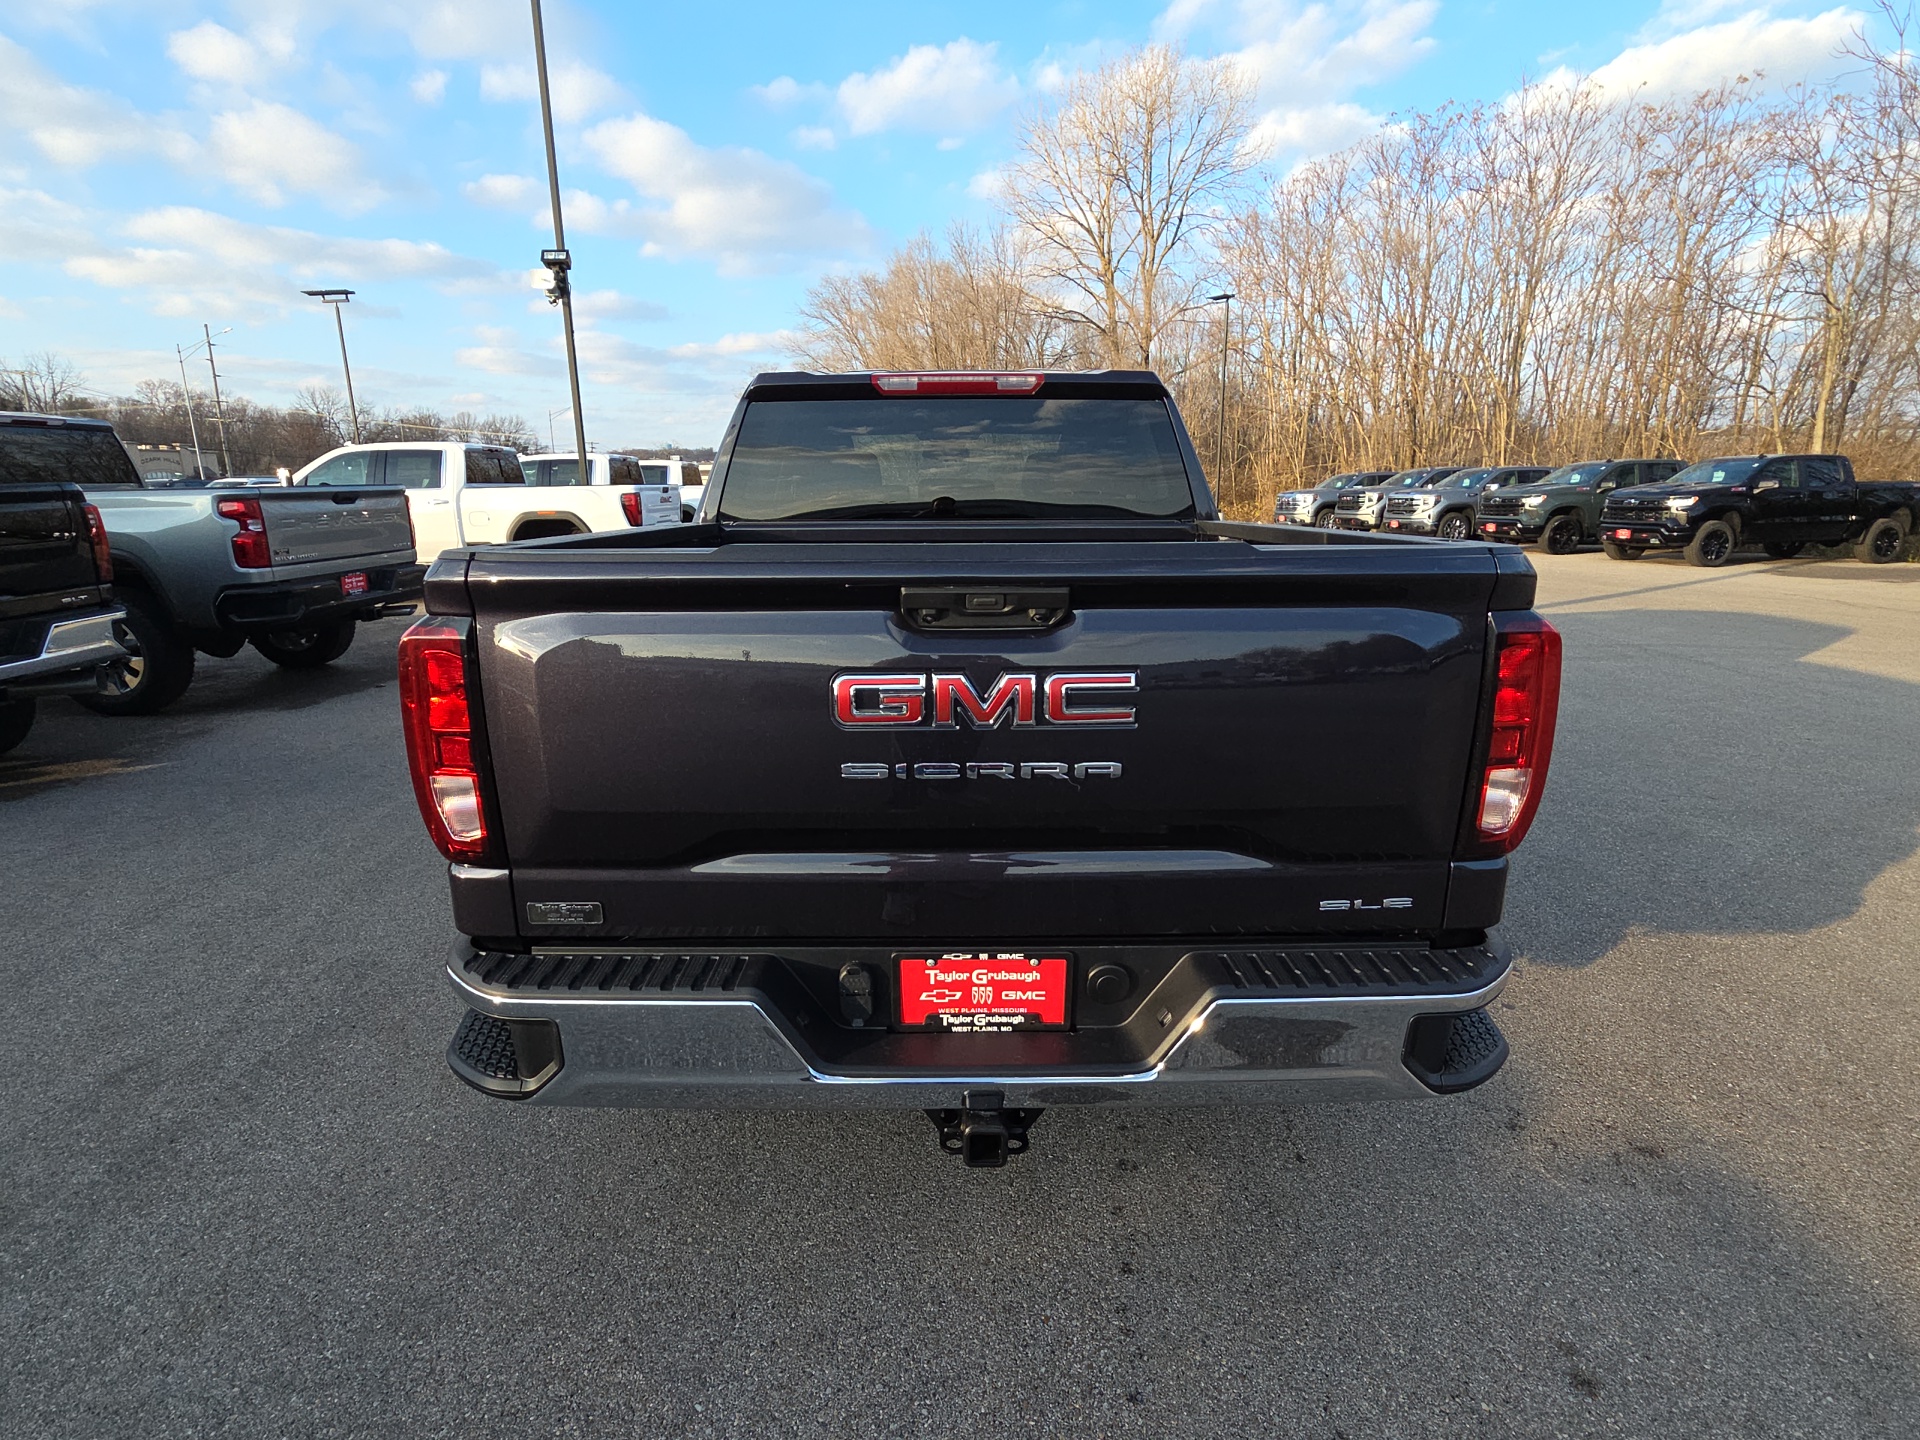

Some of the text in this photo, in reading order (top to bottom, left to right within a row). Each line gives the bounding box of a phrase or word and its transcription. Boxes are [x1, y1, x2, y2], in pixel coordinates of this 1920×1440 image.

[831, 670, 1140, 730] GMC
[841, 762, 1122, 779] SIERRA
[1319, 897, 1413, 911] SLE
[925, 969, 1040, 985] Taylor Grubaugh
[1001, 990, 1046, 1000] GMC
[939, 1014, 1024, 1026] Taylor Grubaugh
